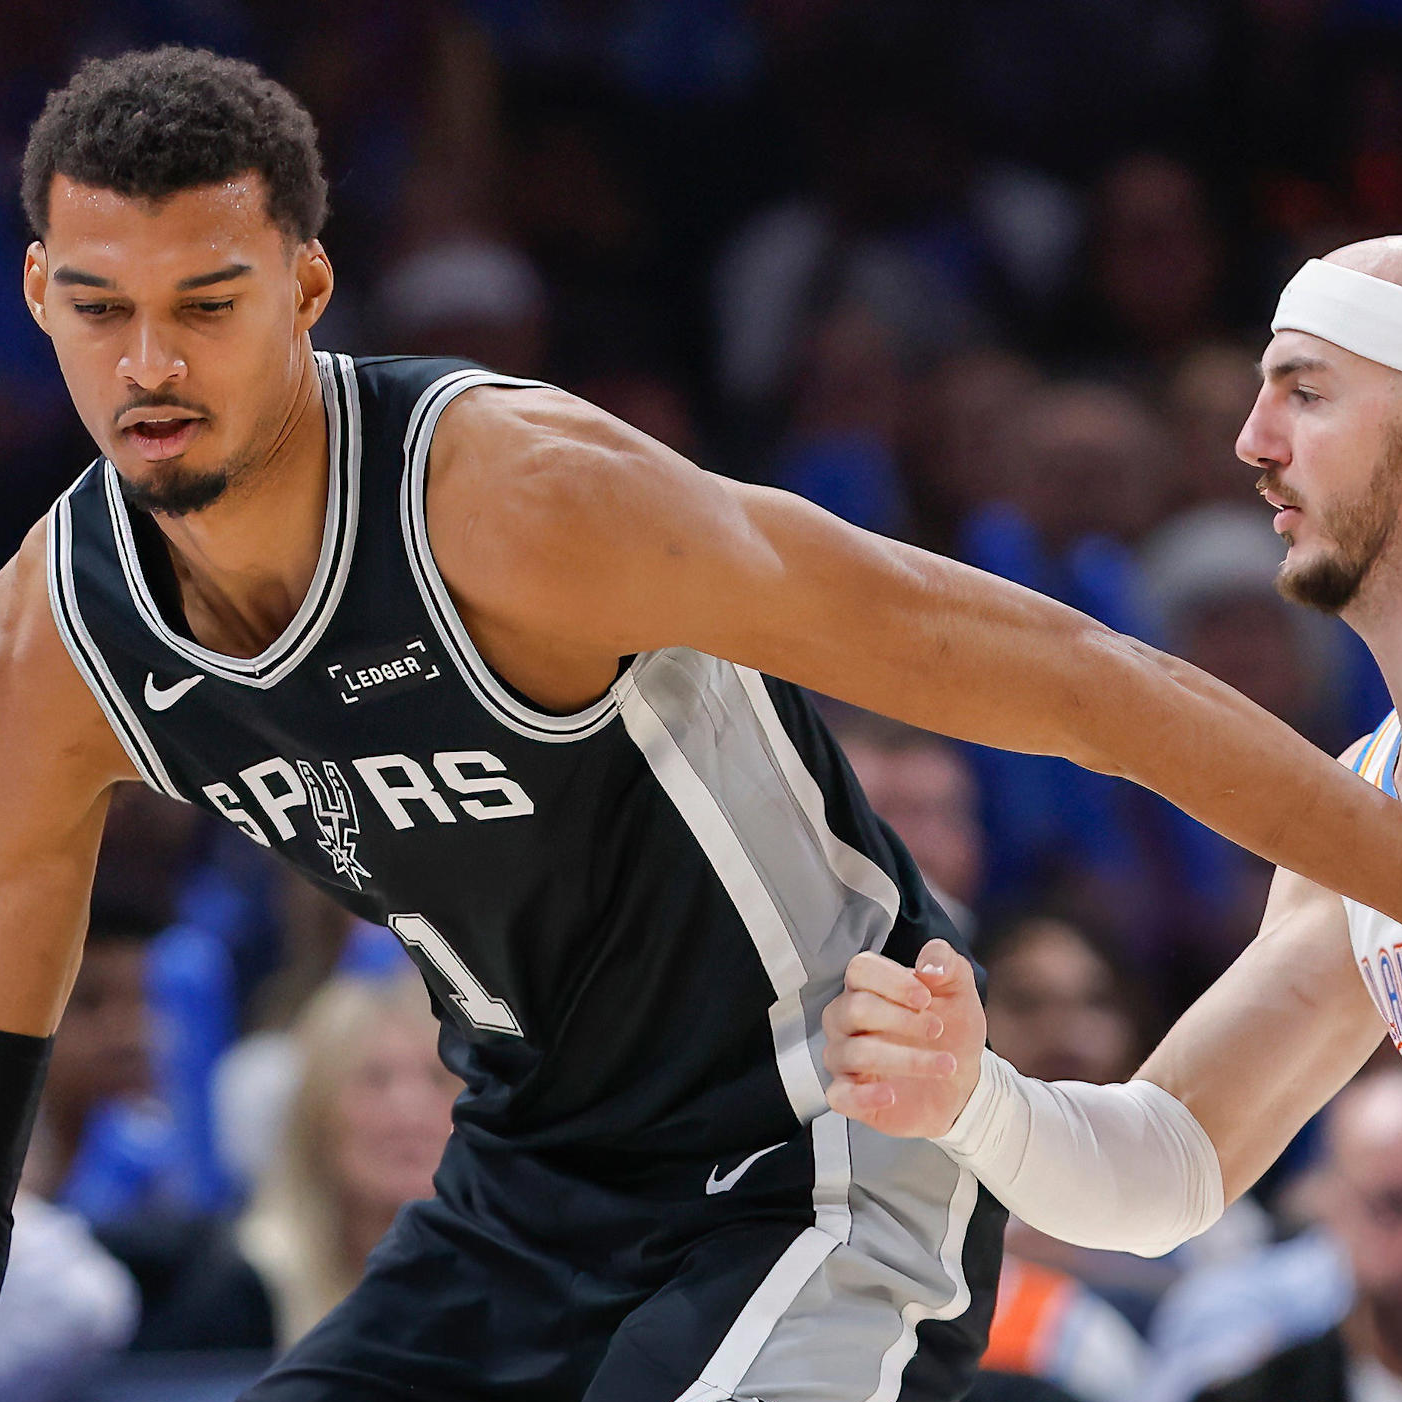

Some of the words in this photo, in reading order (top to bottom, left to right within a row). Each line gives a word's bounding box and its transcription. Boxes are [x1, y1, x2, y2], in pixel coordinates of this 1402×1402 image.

[344, 656, 422, 691] LEDGER
[202, 750, 535, 890] SPURS
[388, 913, 524, 1038] 1
